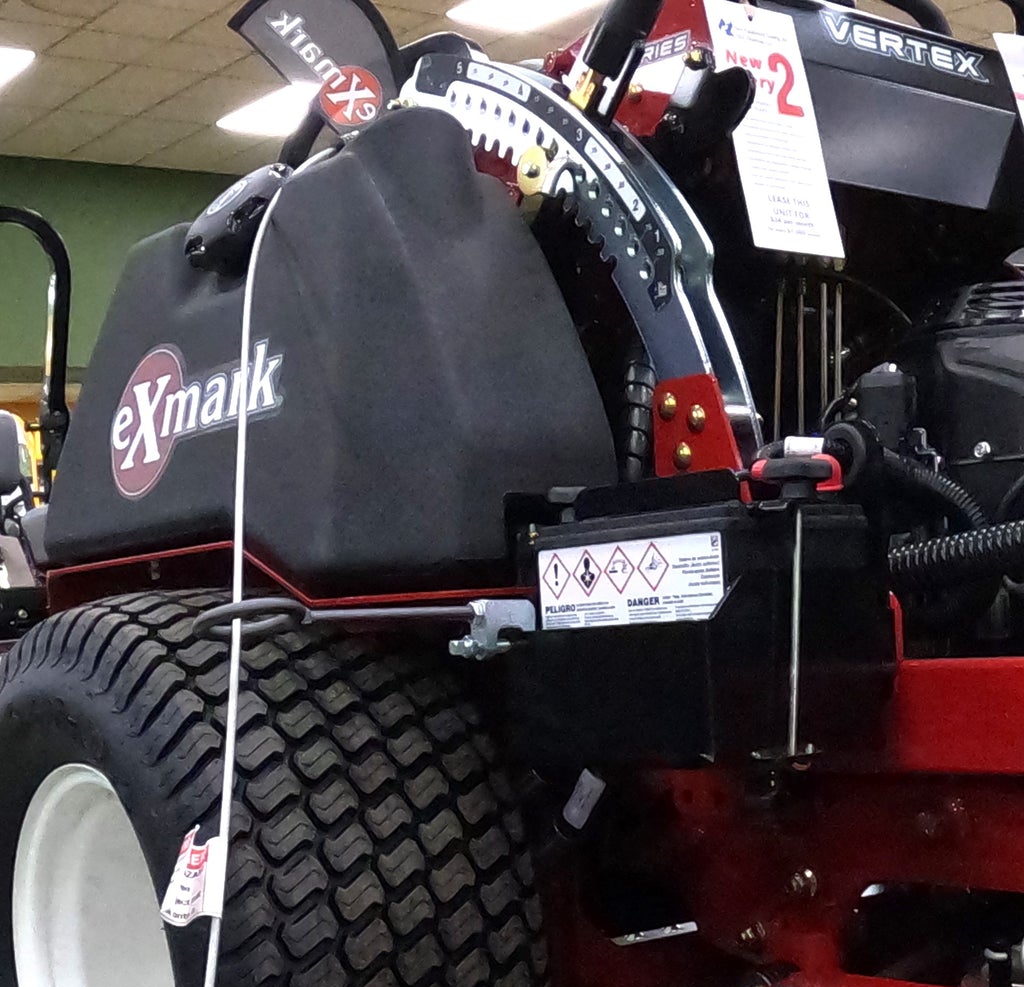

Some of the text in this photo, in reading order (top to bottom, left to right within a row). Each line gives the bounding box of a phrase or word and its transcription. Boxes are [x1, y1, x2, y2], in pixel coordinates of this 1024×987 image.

[641, 33, 688, 66] RIES
[725, 49, 762, 70] New
[821, 11, 987, 81] VERTEX
[767, 52, 805, 118] 2
[576, 127, 583, 142] 3
[632, 200, 640, 212] 2
[112, 341, 283, 471] eXmark
[545, 604, 576, 614] PELIGRO
[627, 596, 660, 607] DANGER
